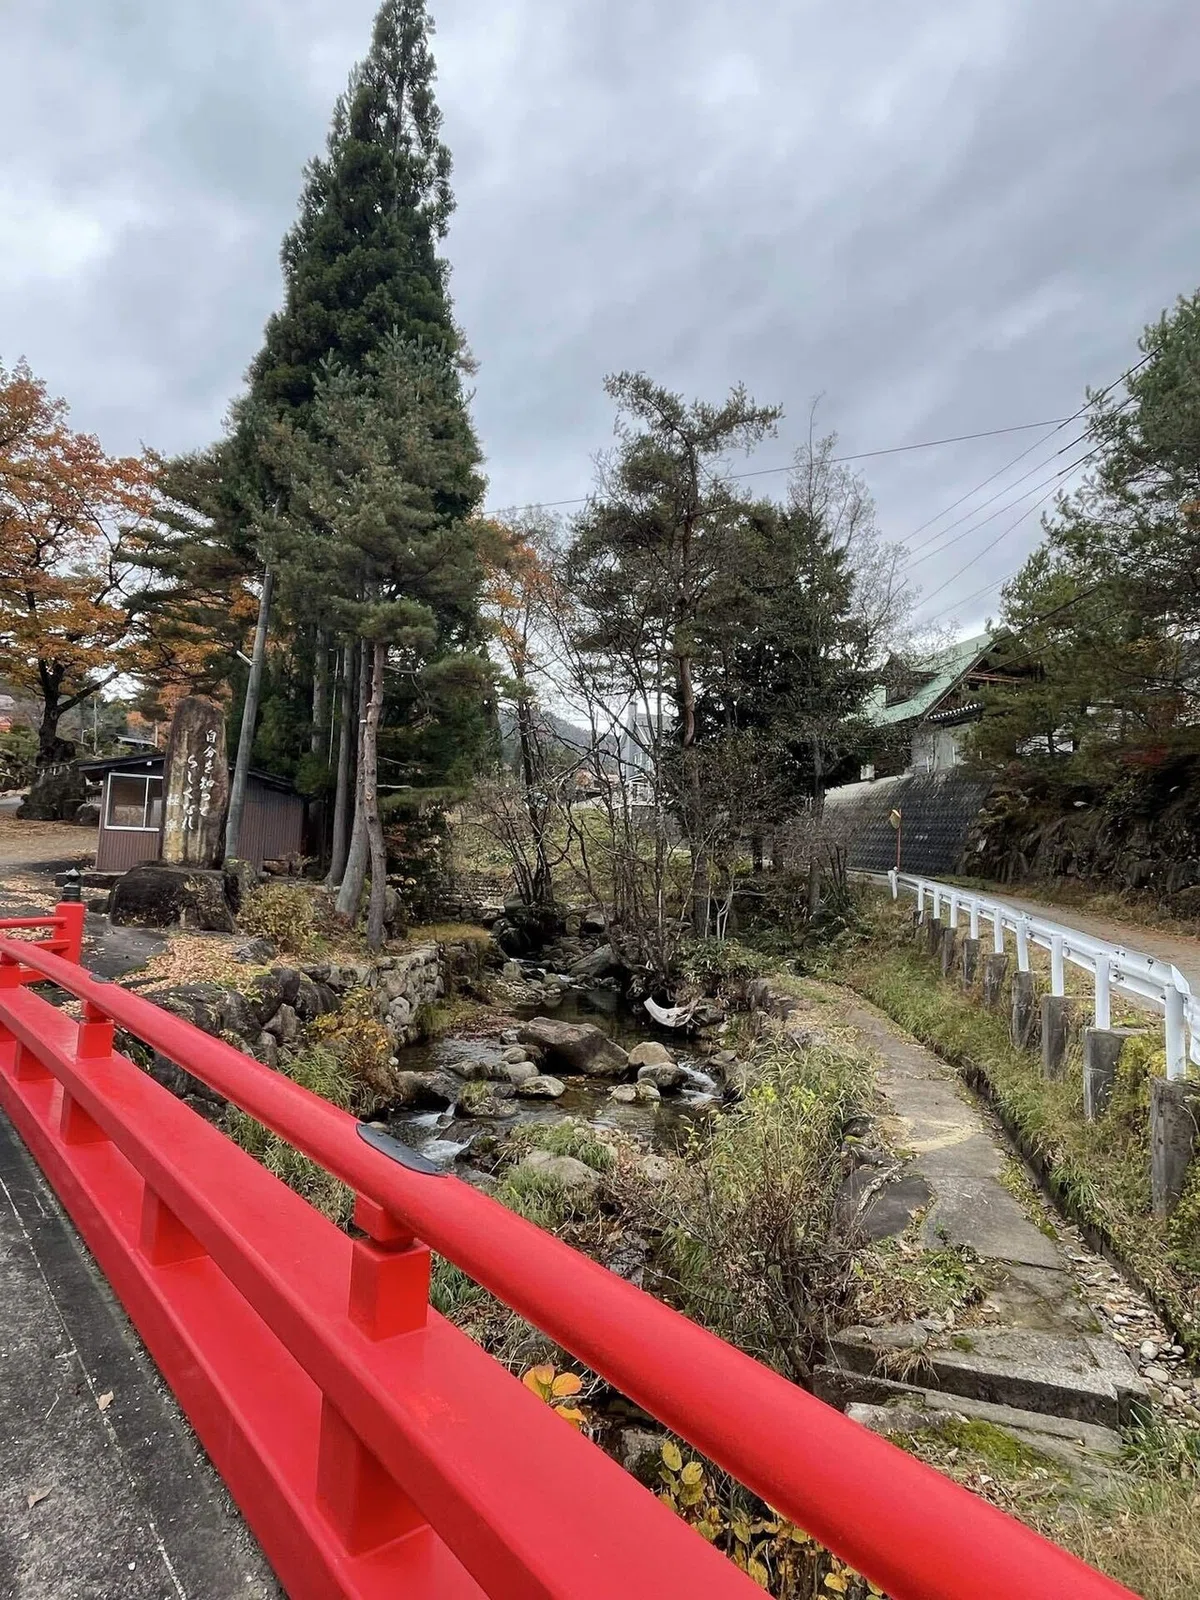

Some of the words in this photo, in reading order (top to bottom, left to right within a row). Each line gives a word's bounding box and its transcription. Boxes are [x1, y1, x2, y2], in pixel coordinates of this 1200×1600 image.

[182, 755, 198, 830] らしくなれ
[199, 729, 217, 817] 自分を知って
